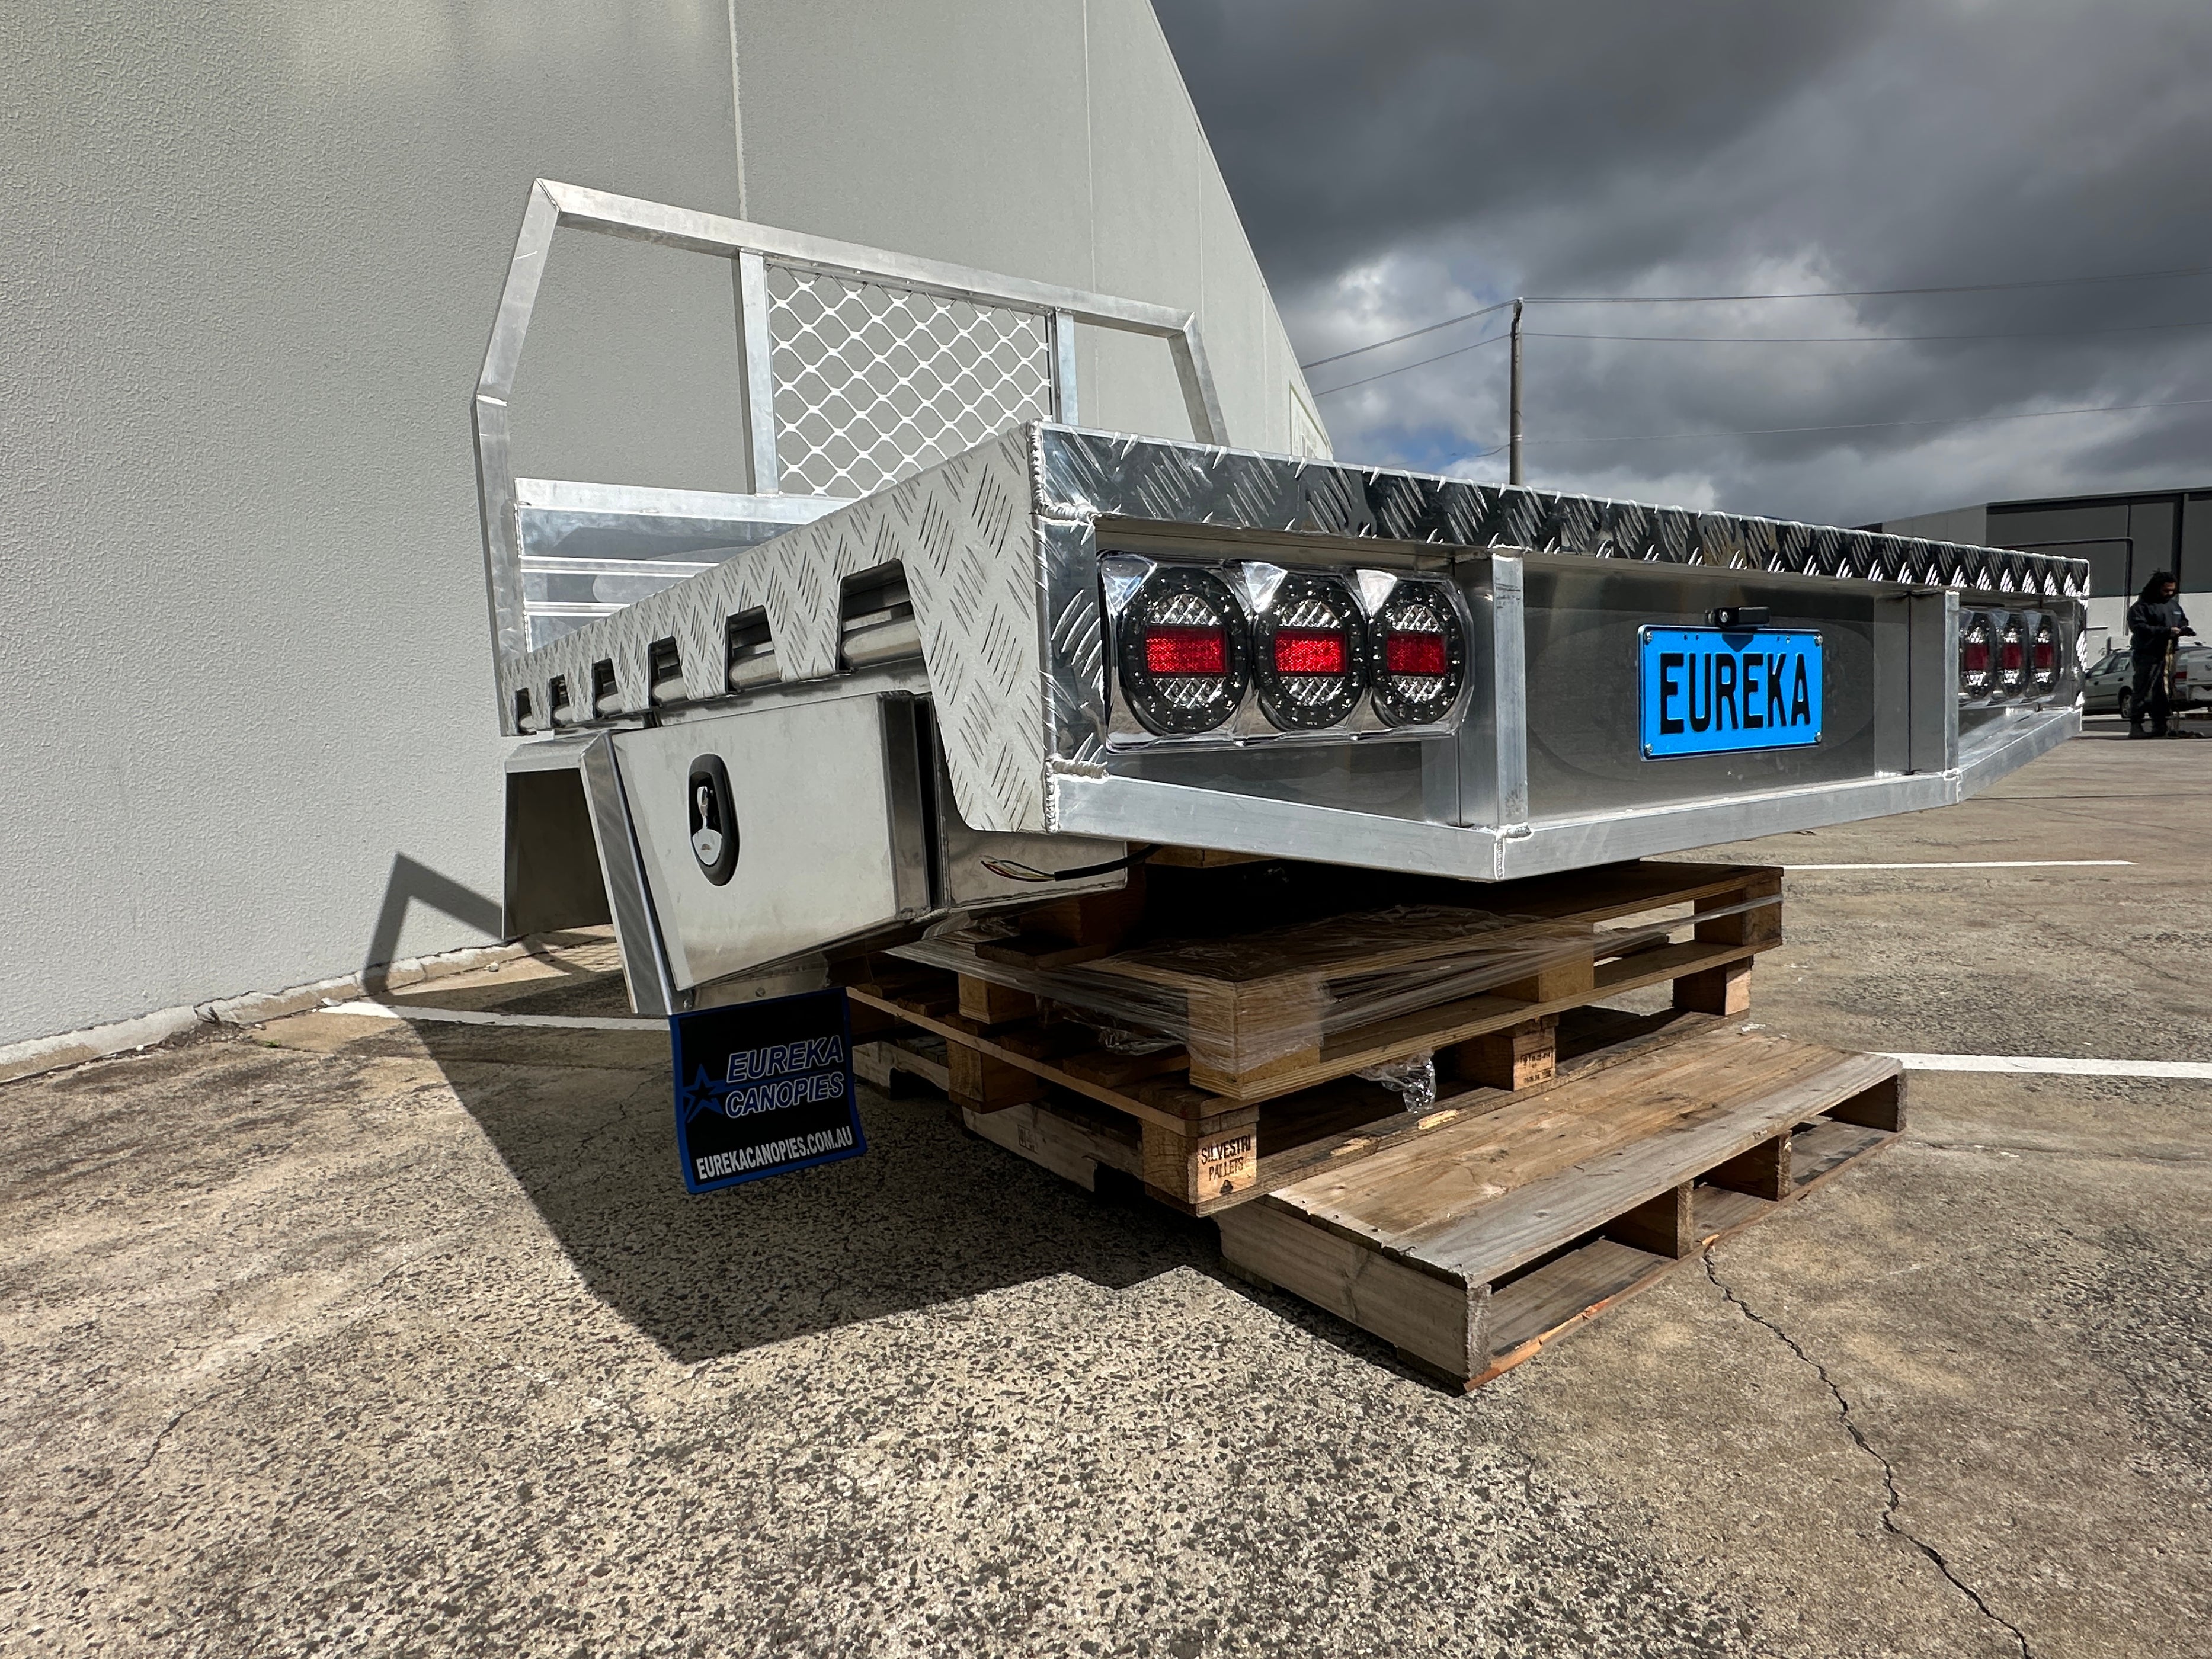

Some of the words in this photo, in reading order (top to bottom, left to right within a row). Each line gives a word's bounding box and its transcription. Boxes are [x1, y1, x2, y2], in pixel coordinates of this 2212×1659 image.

[1660, 652, 1811, 735] EUREKA
[726, 1035, 844, 1084] EUREKA
[725, 1071, 844, 1118] CANOPIES
[696, 1126, 853, 1180] EUREKACANOPIES.COM.AU
[1201, 1133, 1251, 1165] SILVESTRI
[1209, 1157, 1244, 1181] PALLETS
